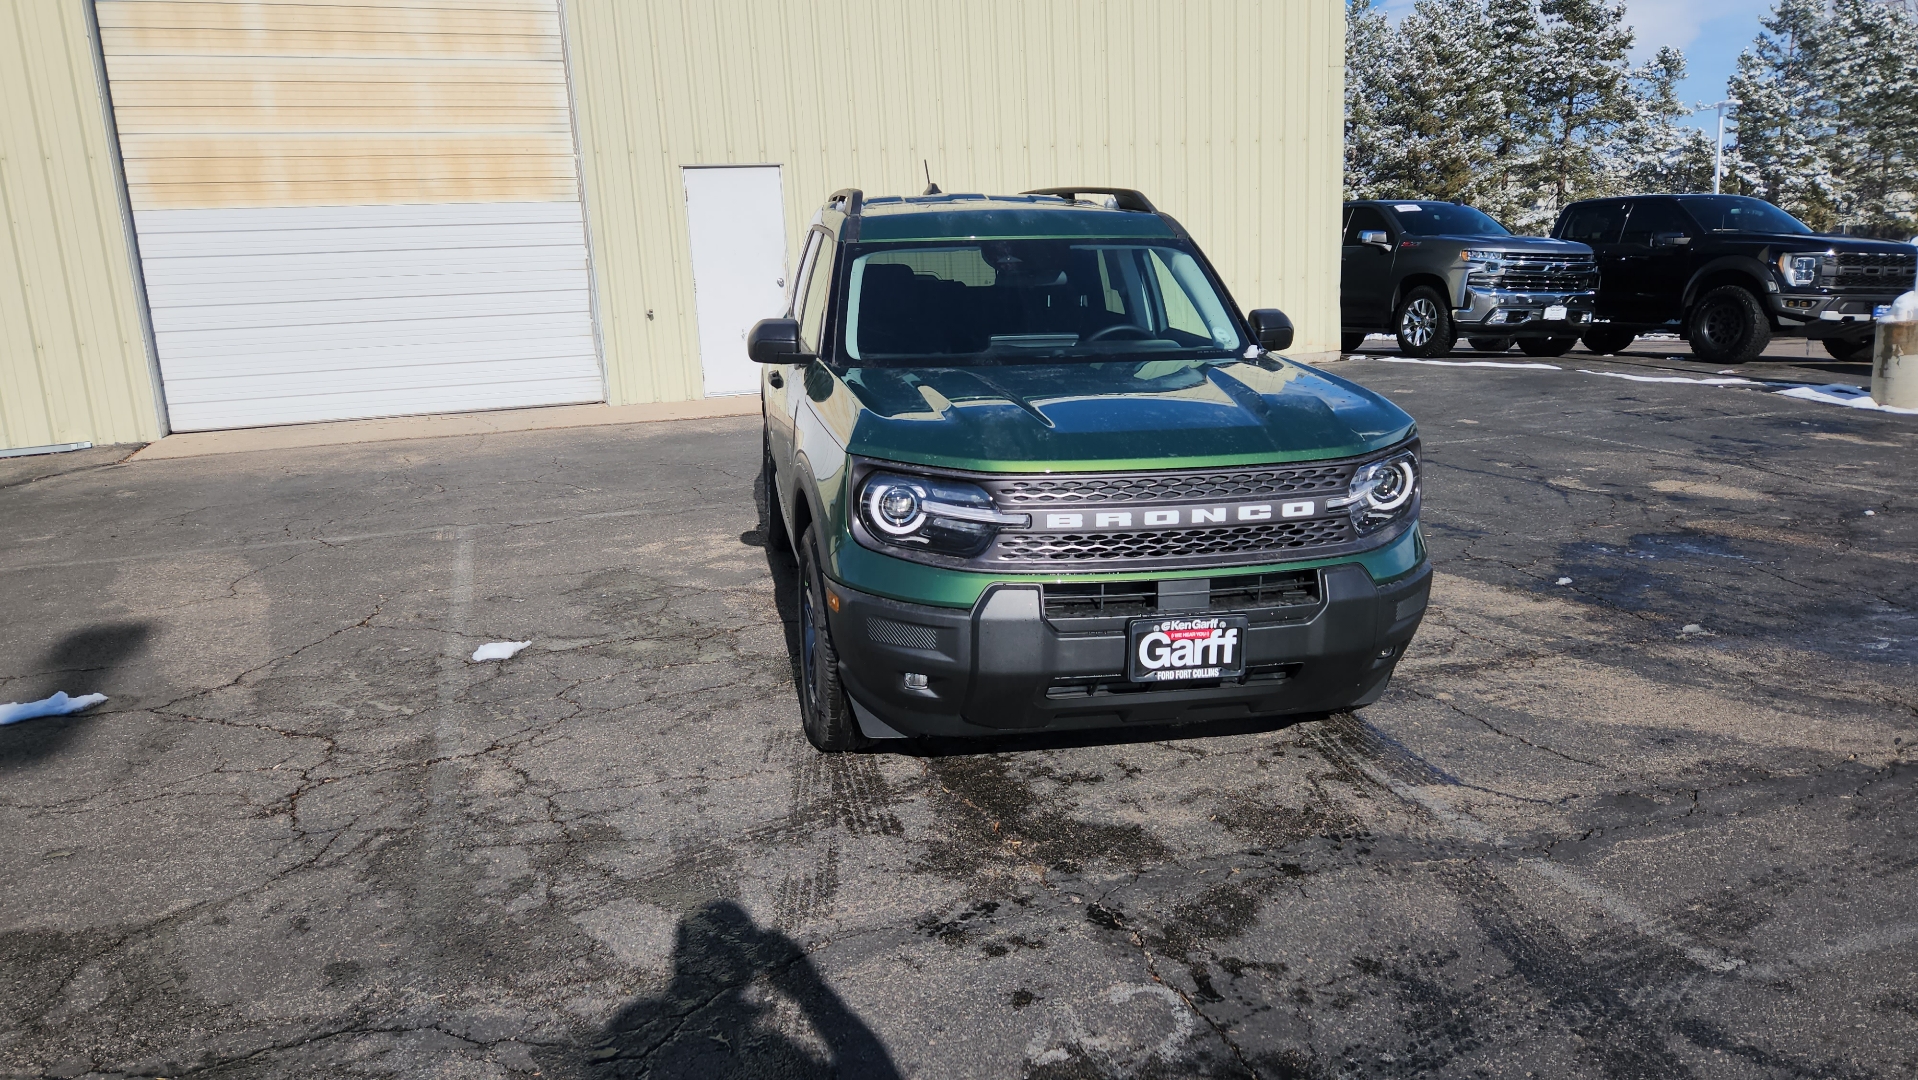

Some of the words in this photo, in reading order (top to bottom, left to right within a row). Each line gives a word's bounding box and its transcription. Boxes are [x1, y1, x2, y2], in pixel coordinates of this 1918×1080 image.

[1046, 501, 1315, 529] BRONCO
[1170, 620, 1192, 631] Ken
[1192, 618, 1219, 630] Garff
[1138, 628, 1238, 670] Garff
[1157, 670, 1175, 680] FORD
[1175, 669, 1192, 679] FORT
[1192, 667, 1220, 679] COLLINS
